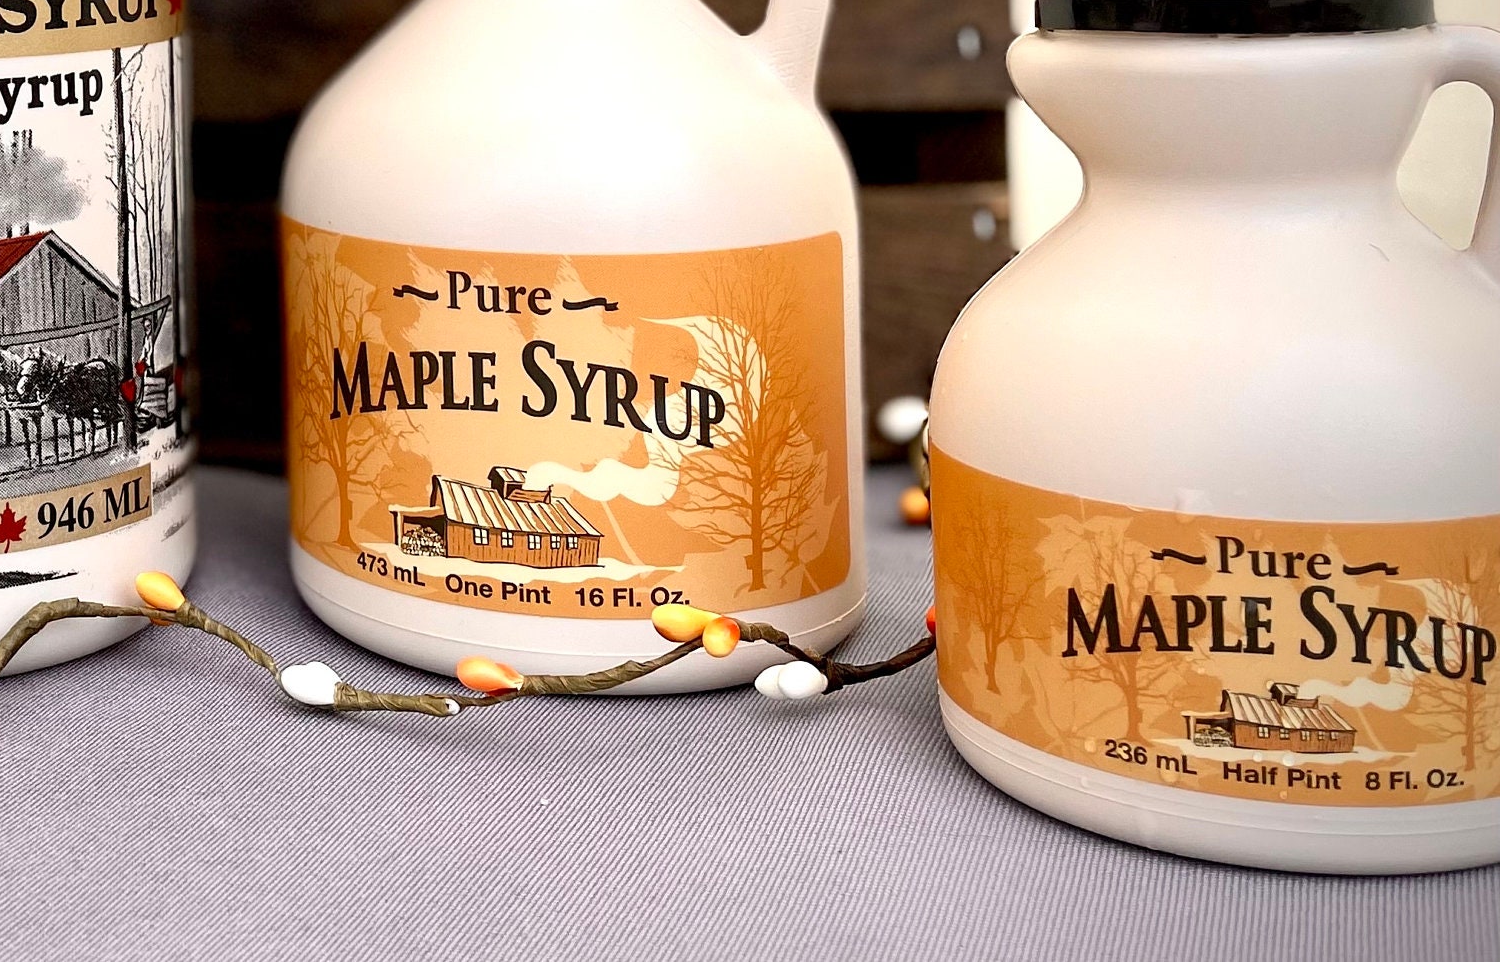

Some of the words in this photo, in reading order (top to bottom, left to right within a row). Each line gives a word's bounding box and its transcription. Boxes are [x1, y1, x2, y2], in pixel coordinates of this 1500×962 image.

[446, 271, 552, 315] Pure
[330, 341, 499, 420] MAPLE
[521, 340, 725, 448] SYRUP
[37, 492, 95, 538] 946
[102, 476, 150, 521] ML
[357, 551, 388, 577] 473
[393, 564, 425, 587] mL
[445, 574, 493, 599] One
[502, 582, 551, 605] Pint
[575, 588, 605, 607] 16
[613, 587, 642, 608] Fl.
[650, 586, 690, 607] Oz.
[1216, 536, 1332, 580] Pure
[1062, 584, 1274, 658] MAPLE
[1300, 586, 1496, 685] SYRUP
[1105, 740, 1147, 765] 236
[1157, 754, 1197, 775] mL
[1223, 761, 1277, 786] Half
[1288, 769, 1341, 790] Pint
[1366, 772, 1381, 790] 8
[1389, 771, 1418, 790] Fl.
[1427, 768, 1464, 789] Oz.
